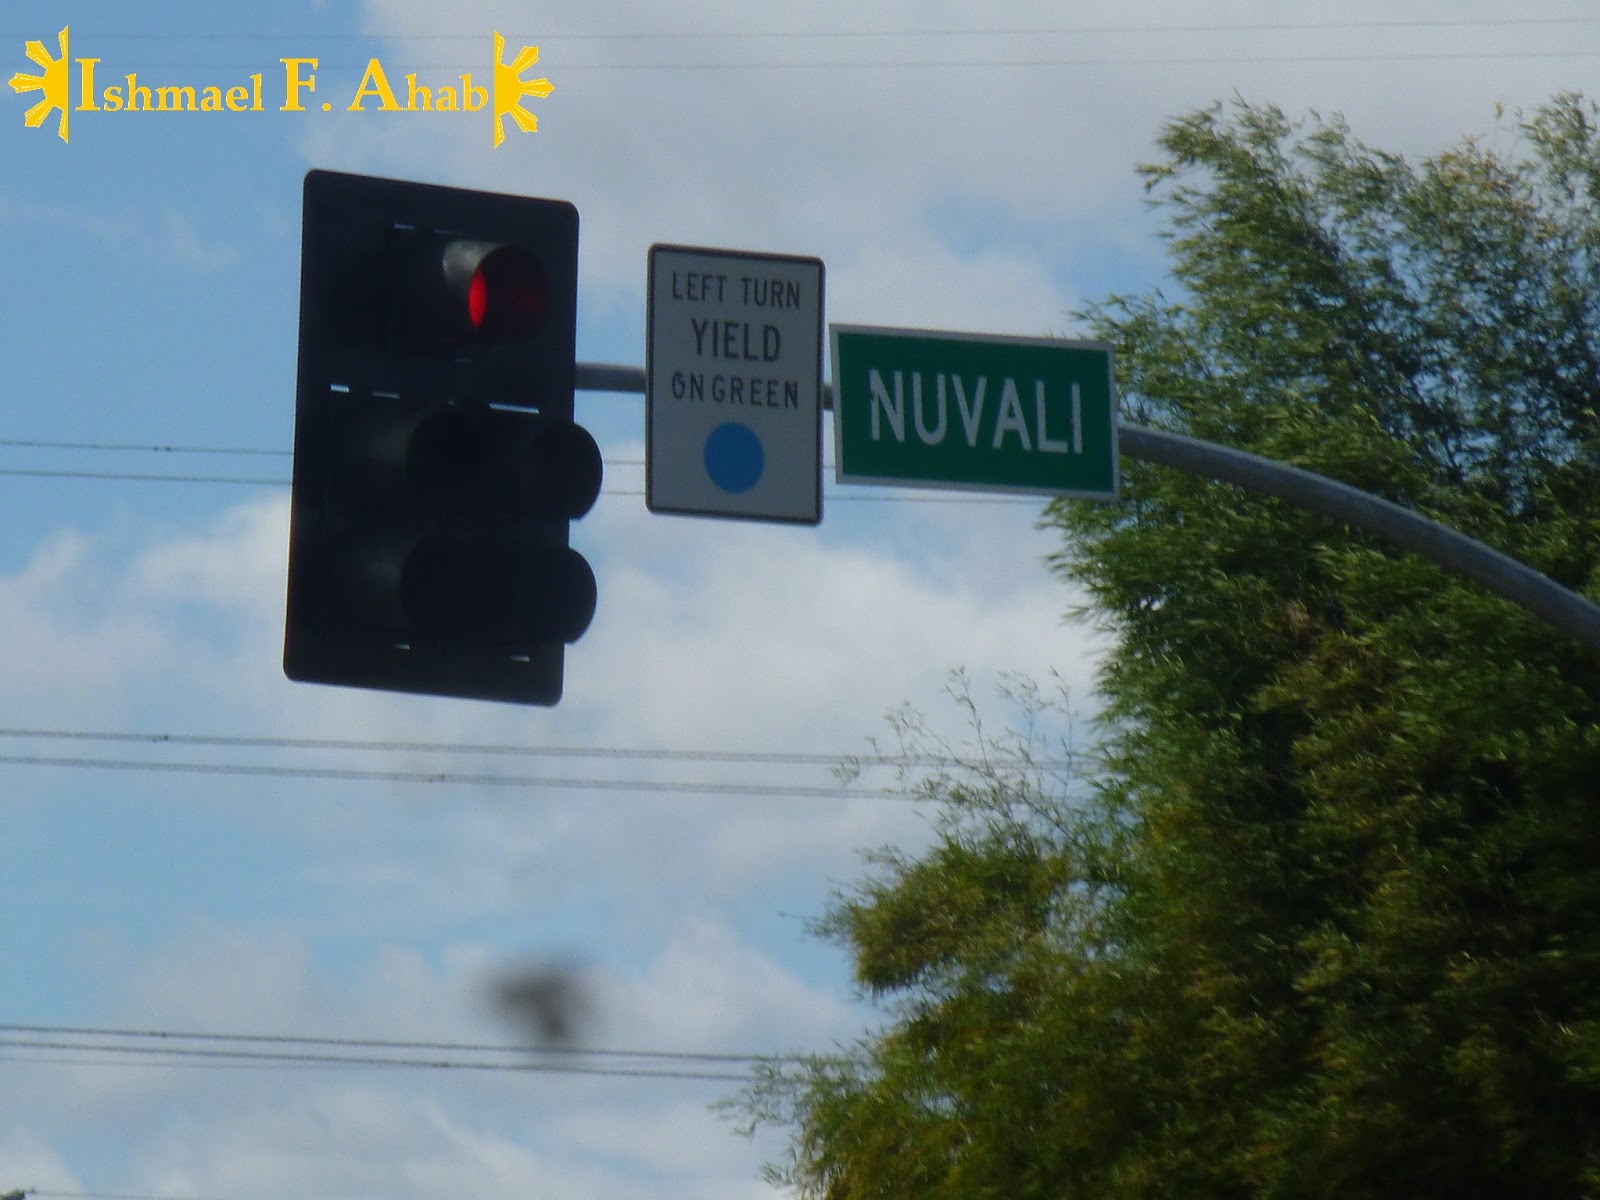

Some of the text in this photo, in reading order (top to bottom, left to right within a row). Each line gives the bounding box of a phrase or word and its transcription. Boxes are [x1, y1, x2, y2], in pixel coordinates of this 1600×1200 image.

[672, 271, 800, 309] LEFT TURN
[691, 317, 781, 363] YIELD
[672, 370, 798, 409] ON GREEN
[868, 368, 1083, 455] NUVALI
